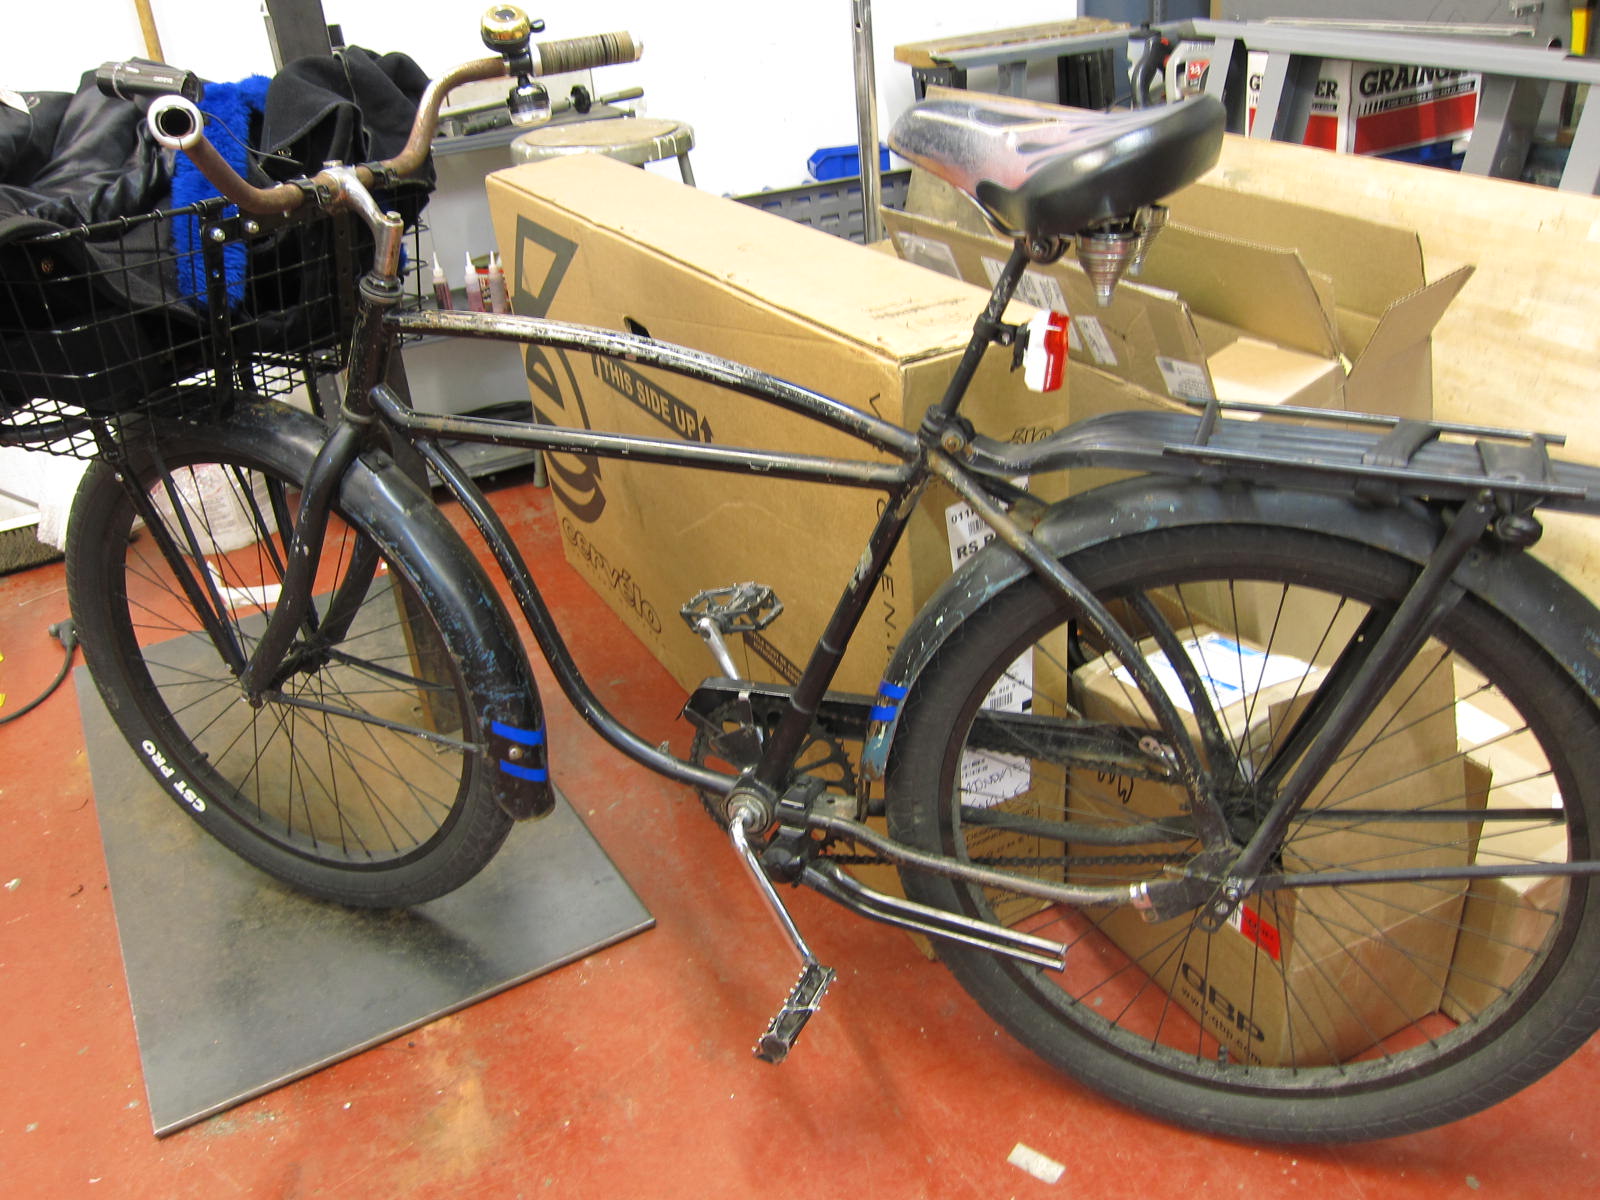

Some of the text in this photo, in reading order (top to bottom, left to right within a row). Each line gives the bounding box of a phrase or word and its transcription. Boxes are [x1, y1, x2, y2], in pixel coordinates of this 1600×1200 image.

[601, 356, 696, 438] THIS SIDE UP
[142, 739, 206, 813] CST PRO
